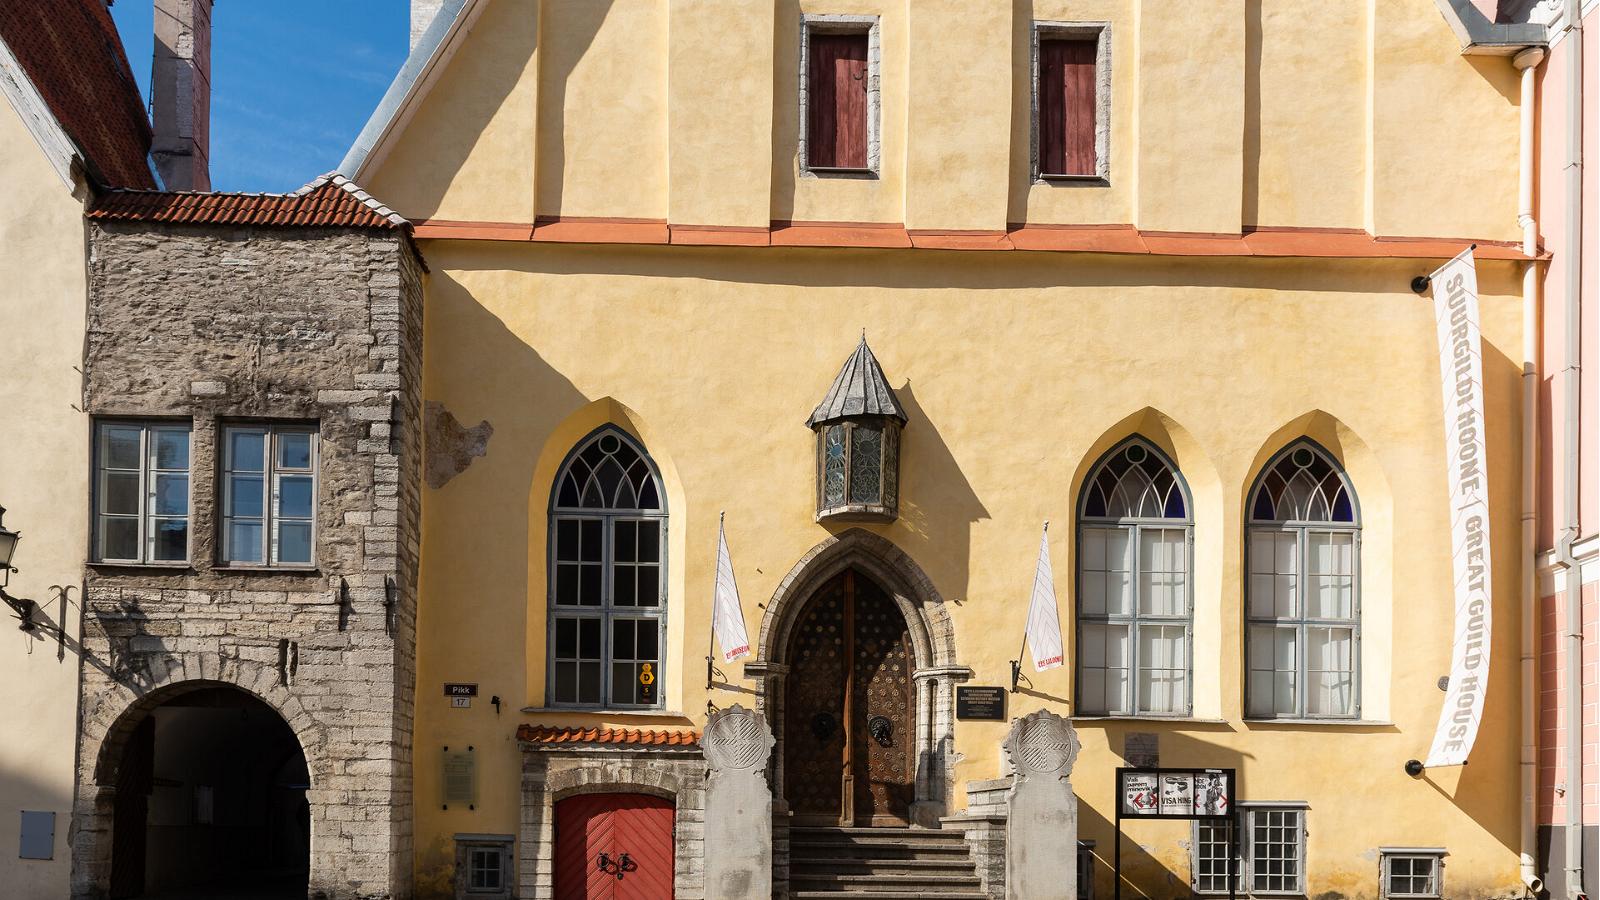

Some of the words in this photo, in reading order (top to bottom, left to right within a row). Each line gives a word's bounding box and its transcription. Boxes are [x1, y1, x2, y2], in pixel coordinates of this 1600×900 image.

[1446, 273, 1475, 406] SUURGILDI
[1457, 410, 1480, 496] HOONE
[1465, 515, 1485, 592] GREAT
[1465, 599, 1485, 671] GUILD
[452, 686, 470, 694] Pikk
[456, 698, 466, 706] 17
[1442, 676, 1478, 753] HOUSE
[1161, 797, 1177, 805] VISA
